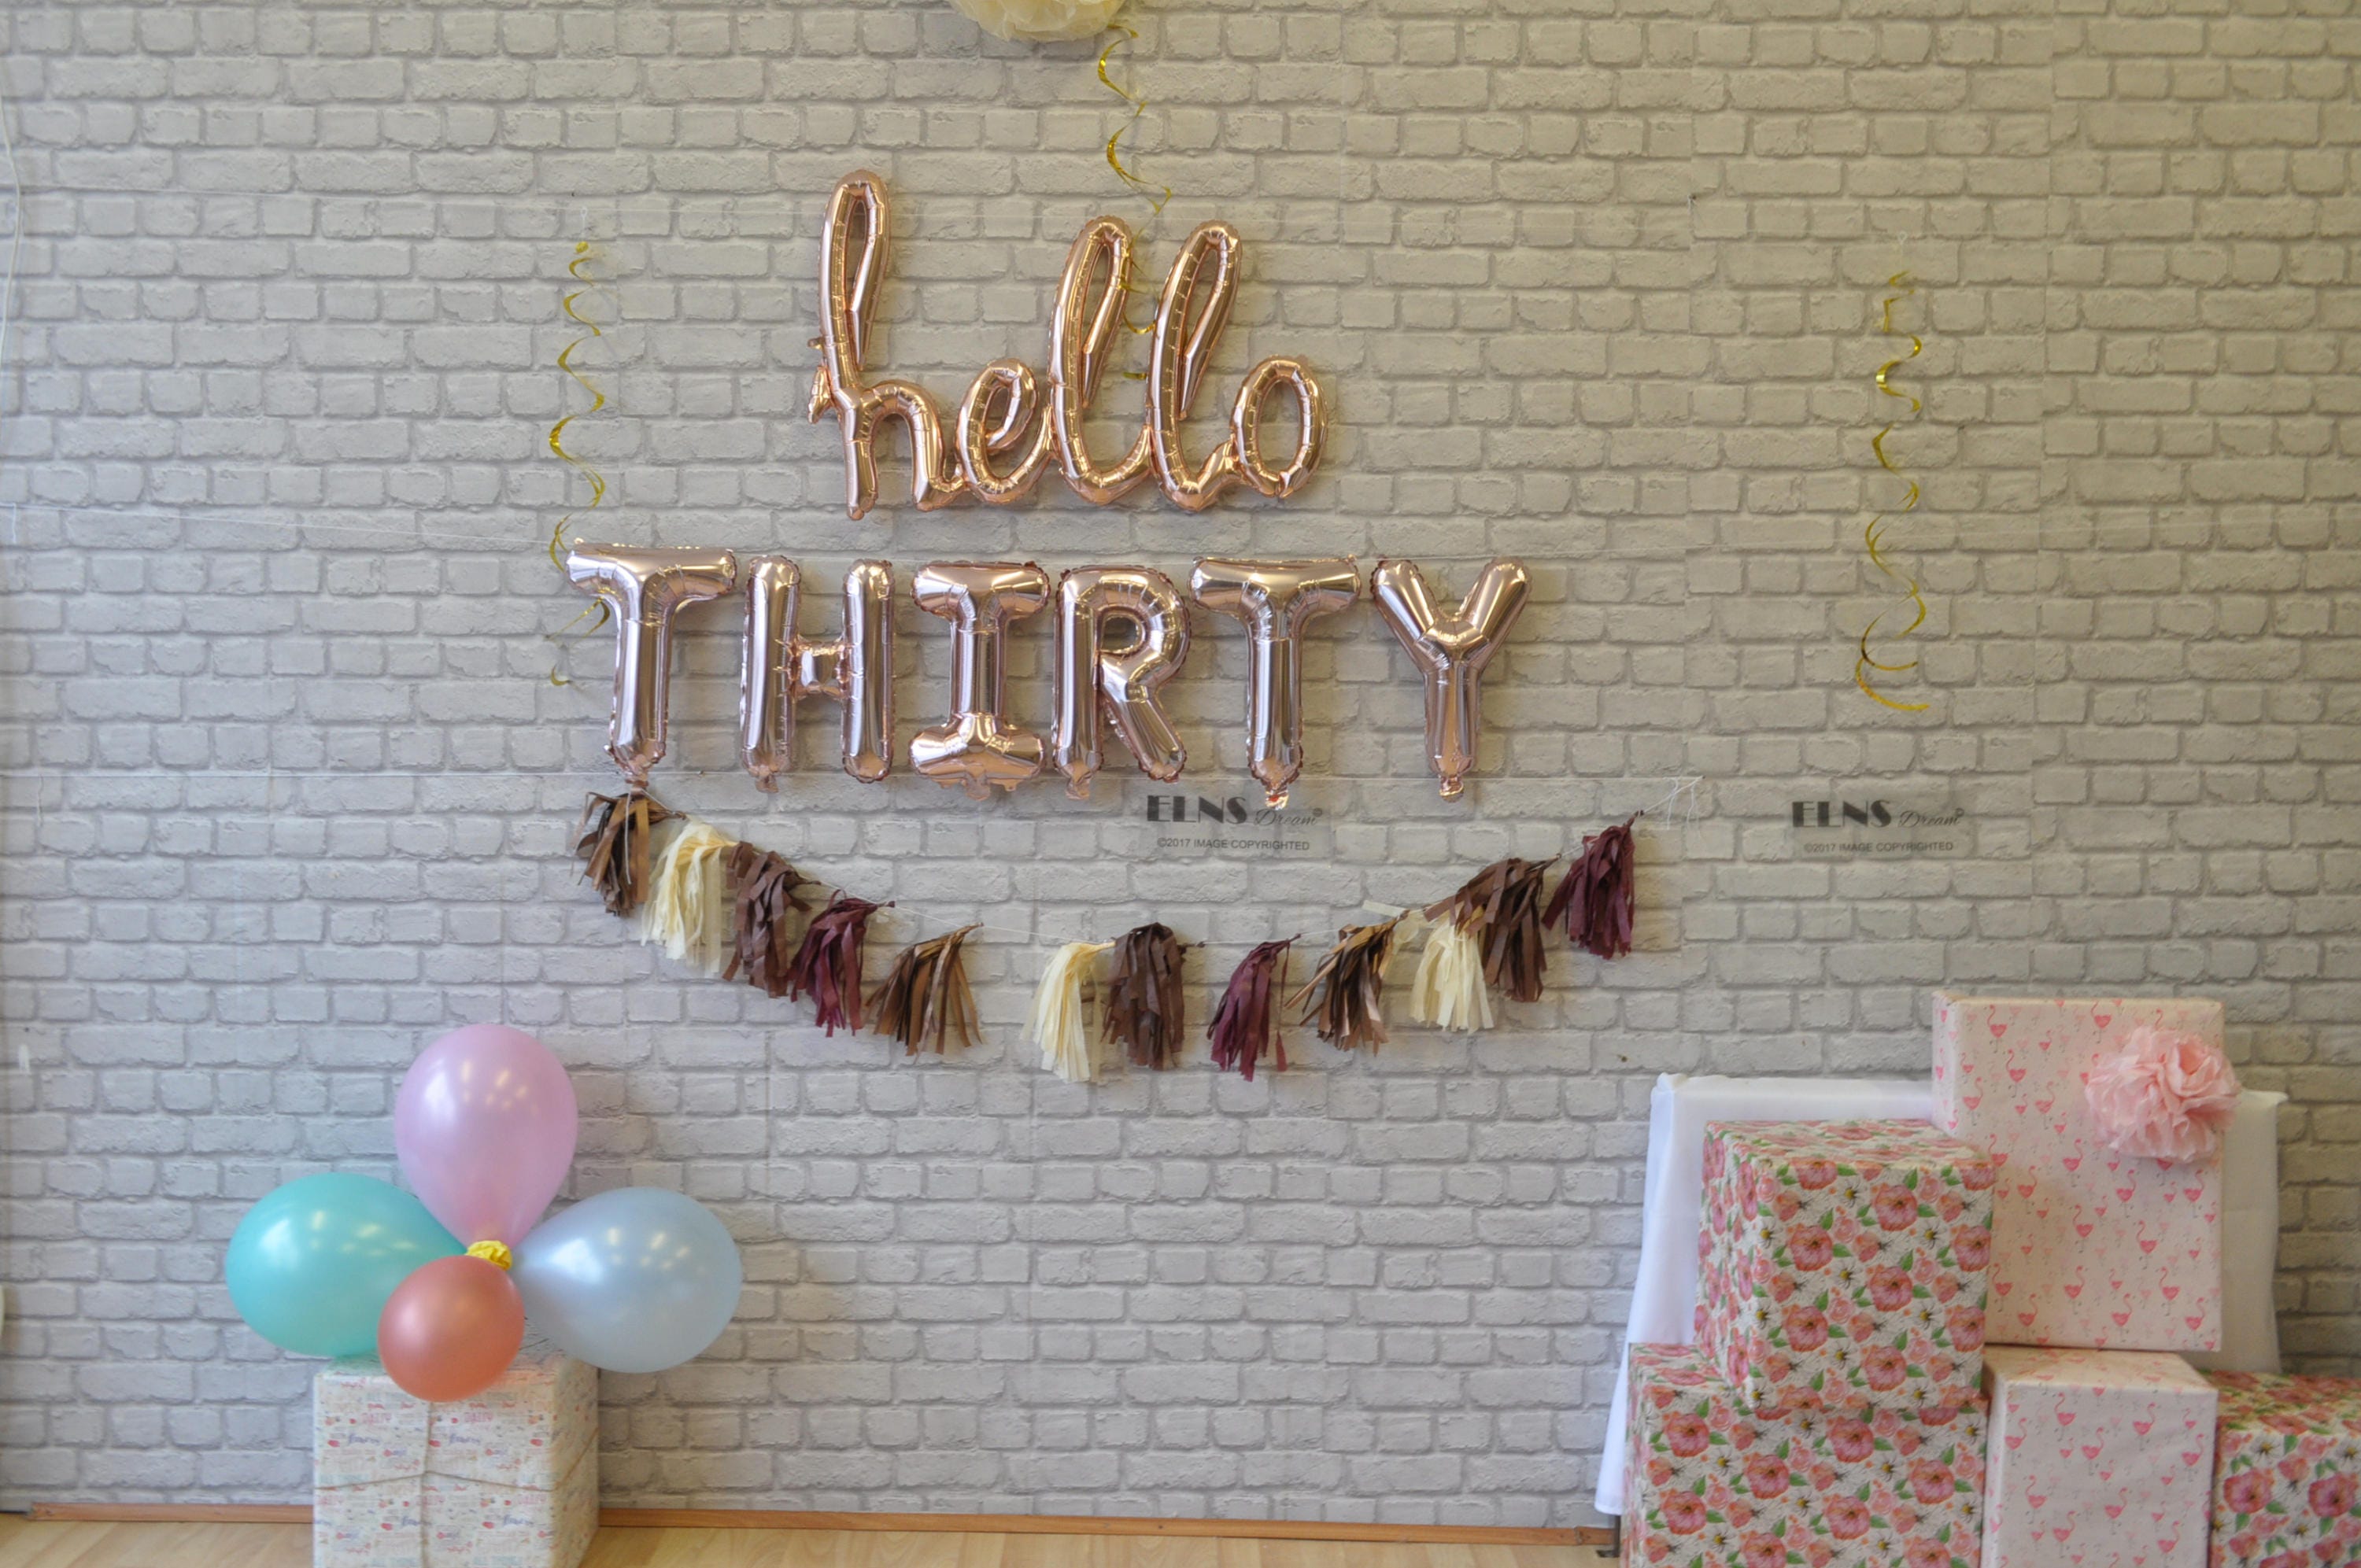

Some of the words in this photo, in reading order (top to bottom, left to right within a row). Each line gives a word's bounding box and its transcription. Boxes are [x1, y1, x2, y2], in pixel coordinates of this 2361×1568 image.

[808, 169, 1328, 520] hello
[566, 540, 1533, 808] THIRTY
[1147, 795, 1247, 824] ELNS
[1792, 799, 1891, 828] ELNS
[1194, 839, 1228, 848] IMAGE
[1231, 839, 1310, 850] COPYRIGHTED
[1839, 843, 1872, 852] IMAGE
[1876, 842, 1953, 852] COPYRIGHTED
